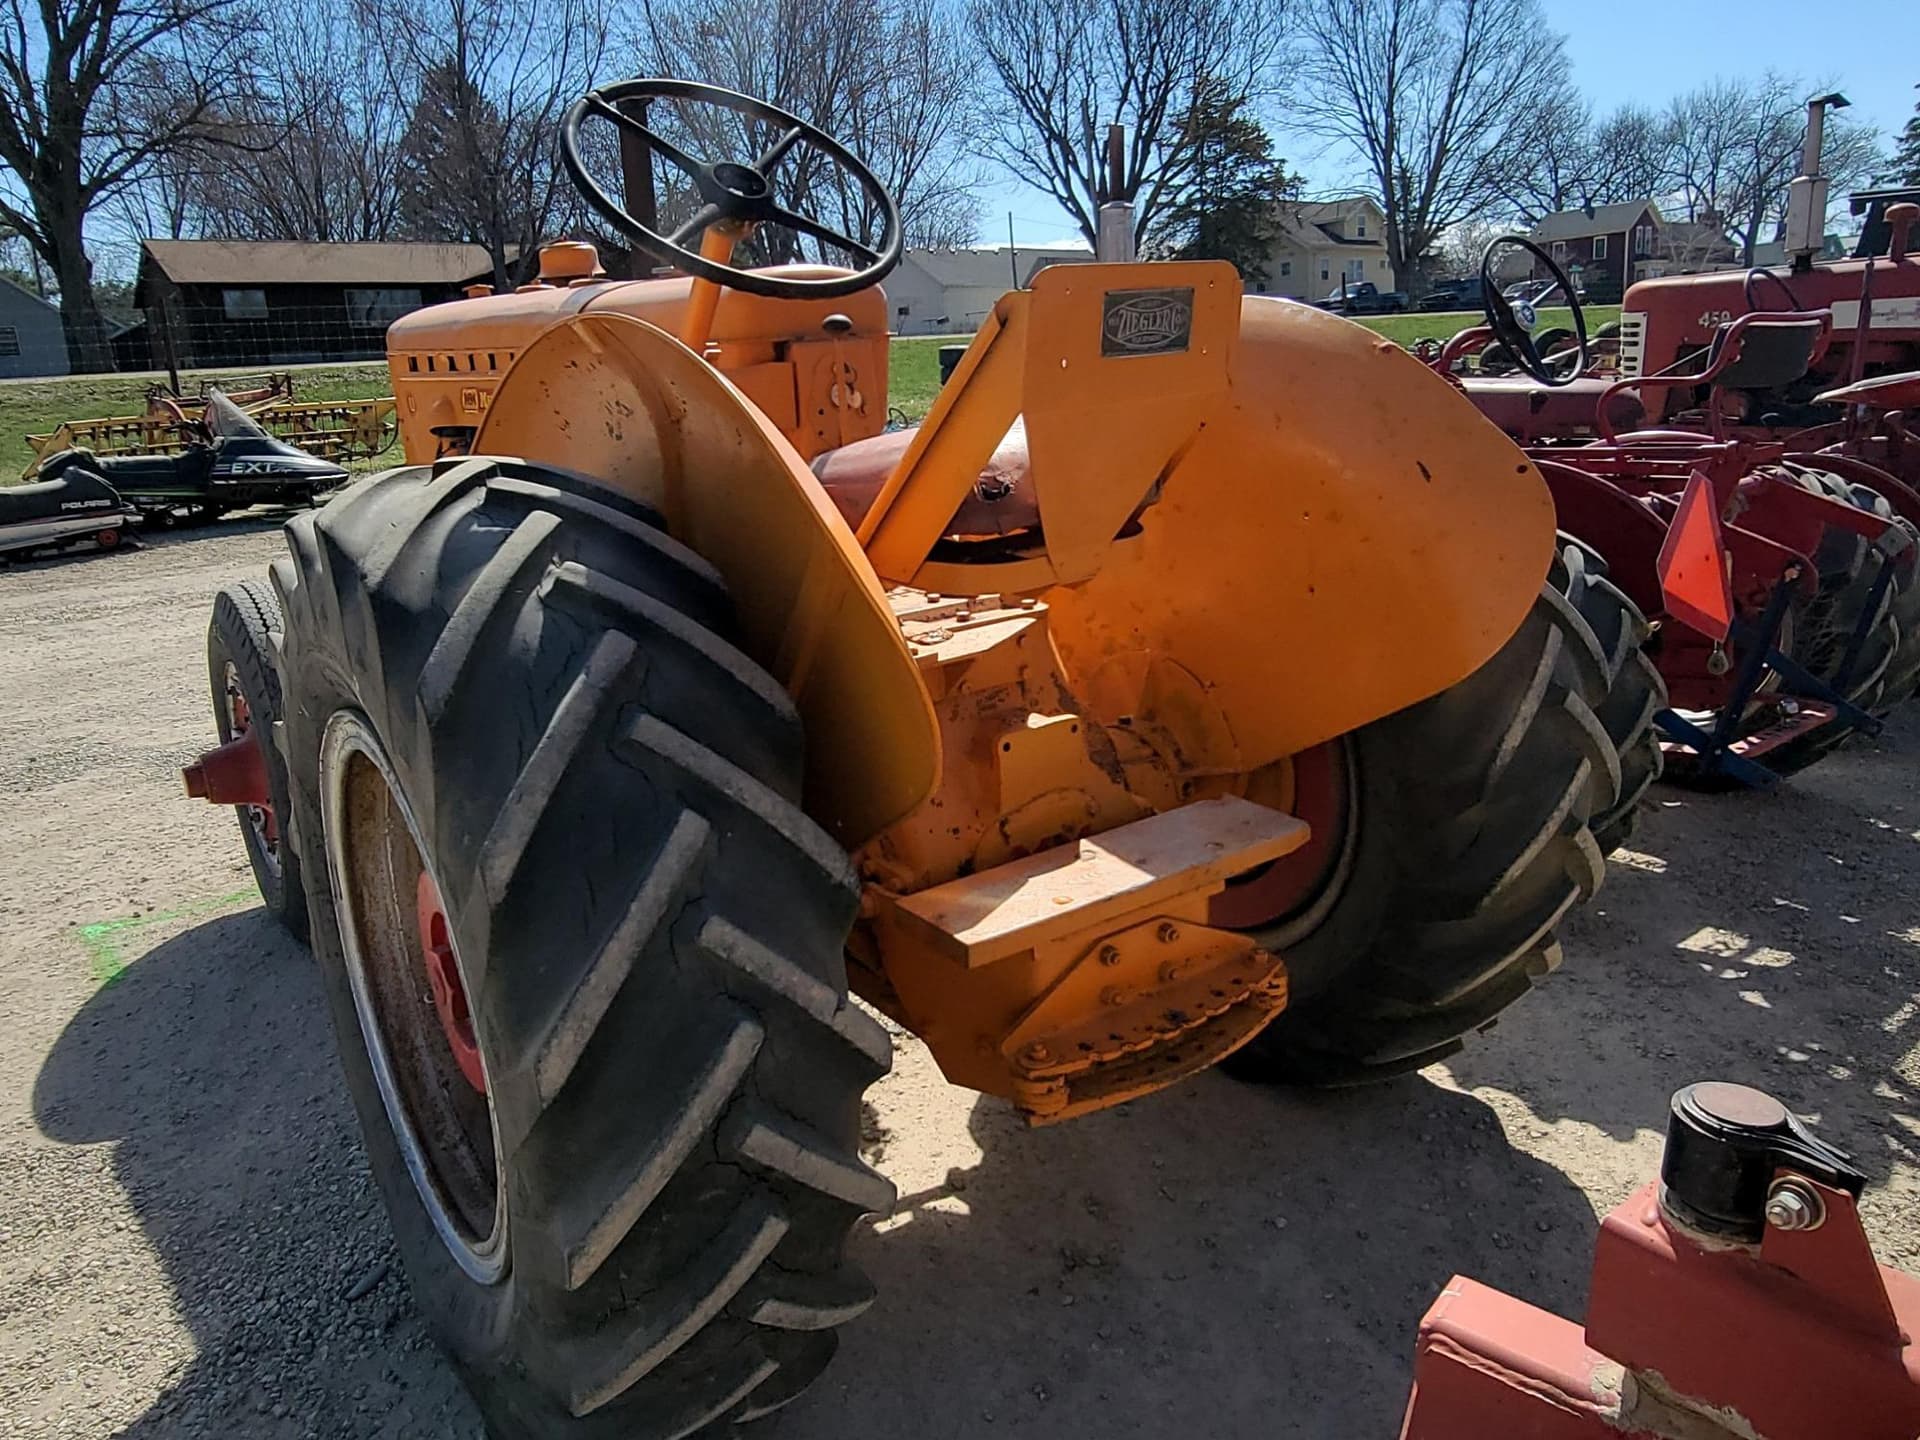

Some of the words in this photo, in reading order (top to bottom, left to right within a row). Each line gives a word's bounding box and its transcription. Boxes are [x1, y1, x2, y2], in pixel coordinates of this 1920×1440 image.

[1117, 309, 1170, 338] ZIEGLER
[231, 462, 275, 473] EXT
[61, 499, 111, 510] POLARIS
